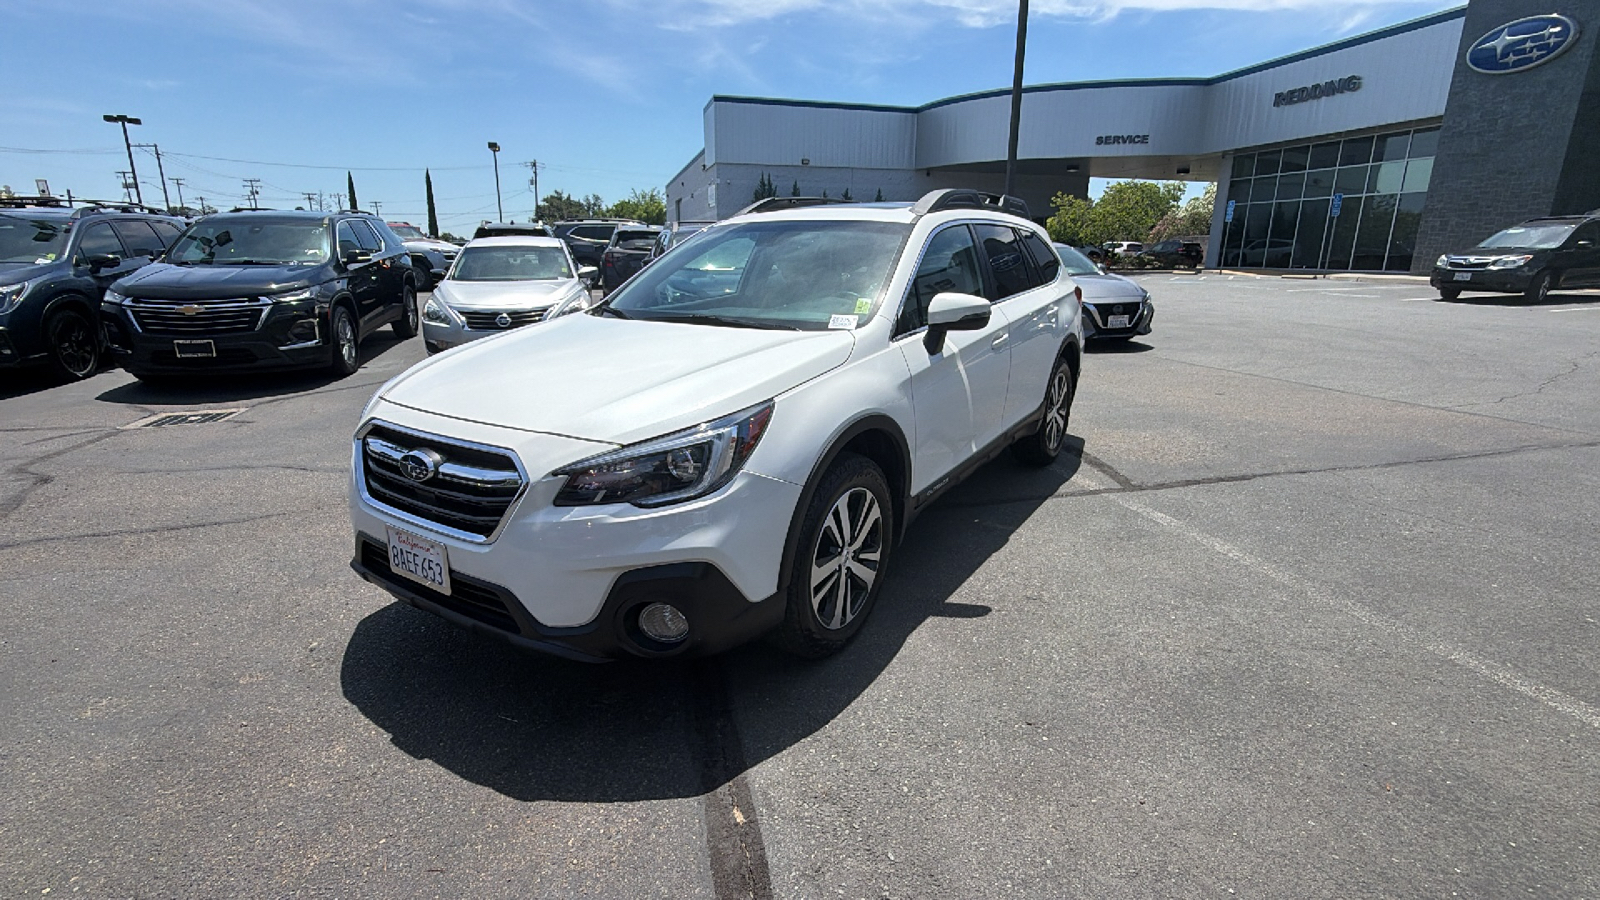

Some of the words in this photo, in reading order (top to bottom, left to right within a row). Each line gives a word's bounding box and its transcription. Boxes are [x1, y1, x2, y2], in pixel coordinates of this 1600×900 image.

[1273, 75, 1362, 107] REDDING
[1096, 135, 1149, 145] SERVICE
[397, 535, 431, 552] California
[391, 545, 444, 586] 8AEF653
